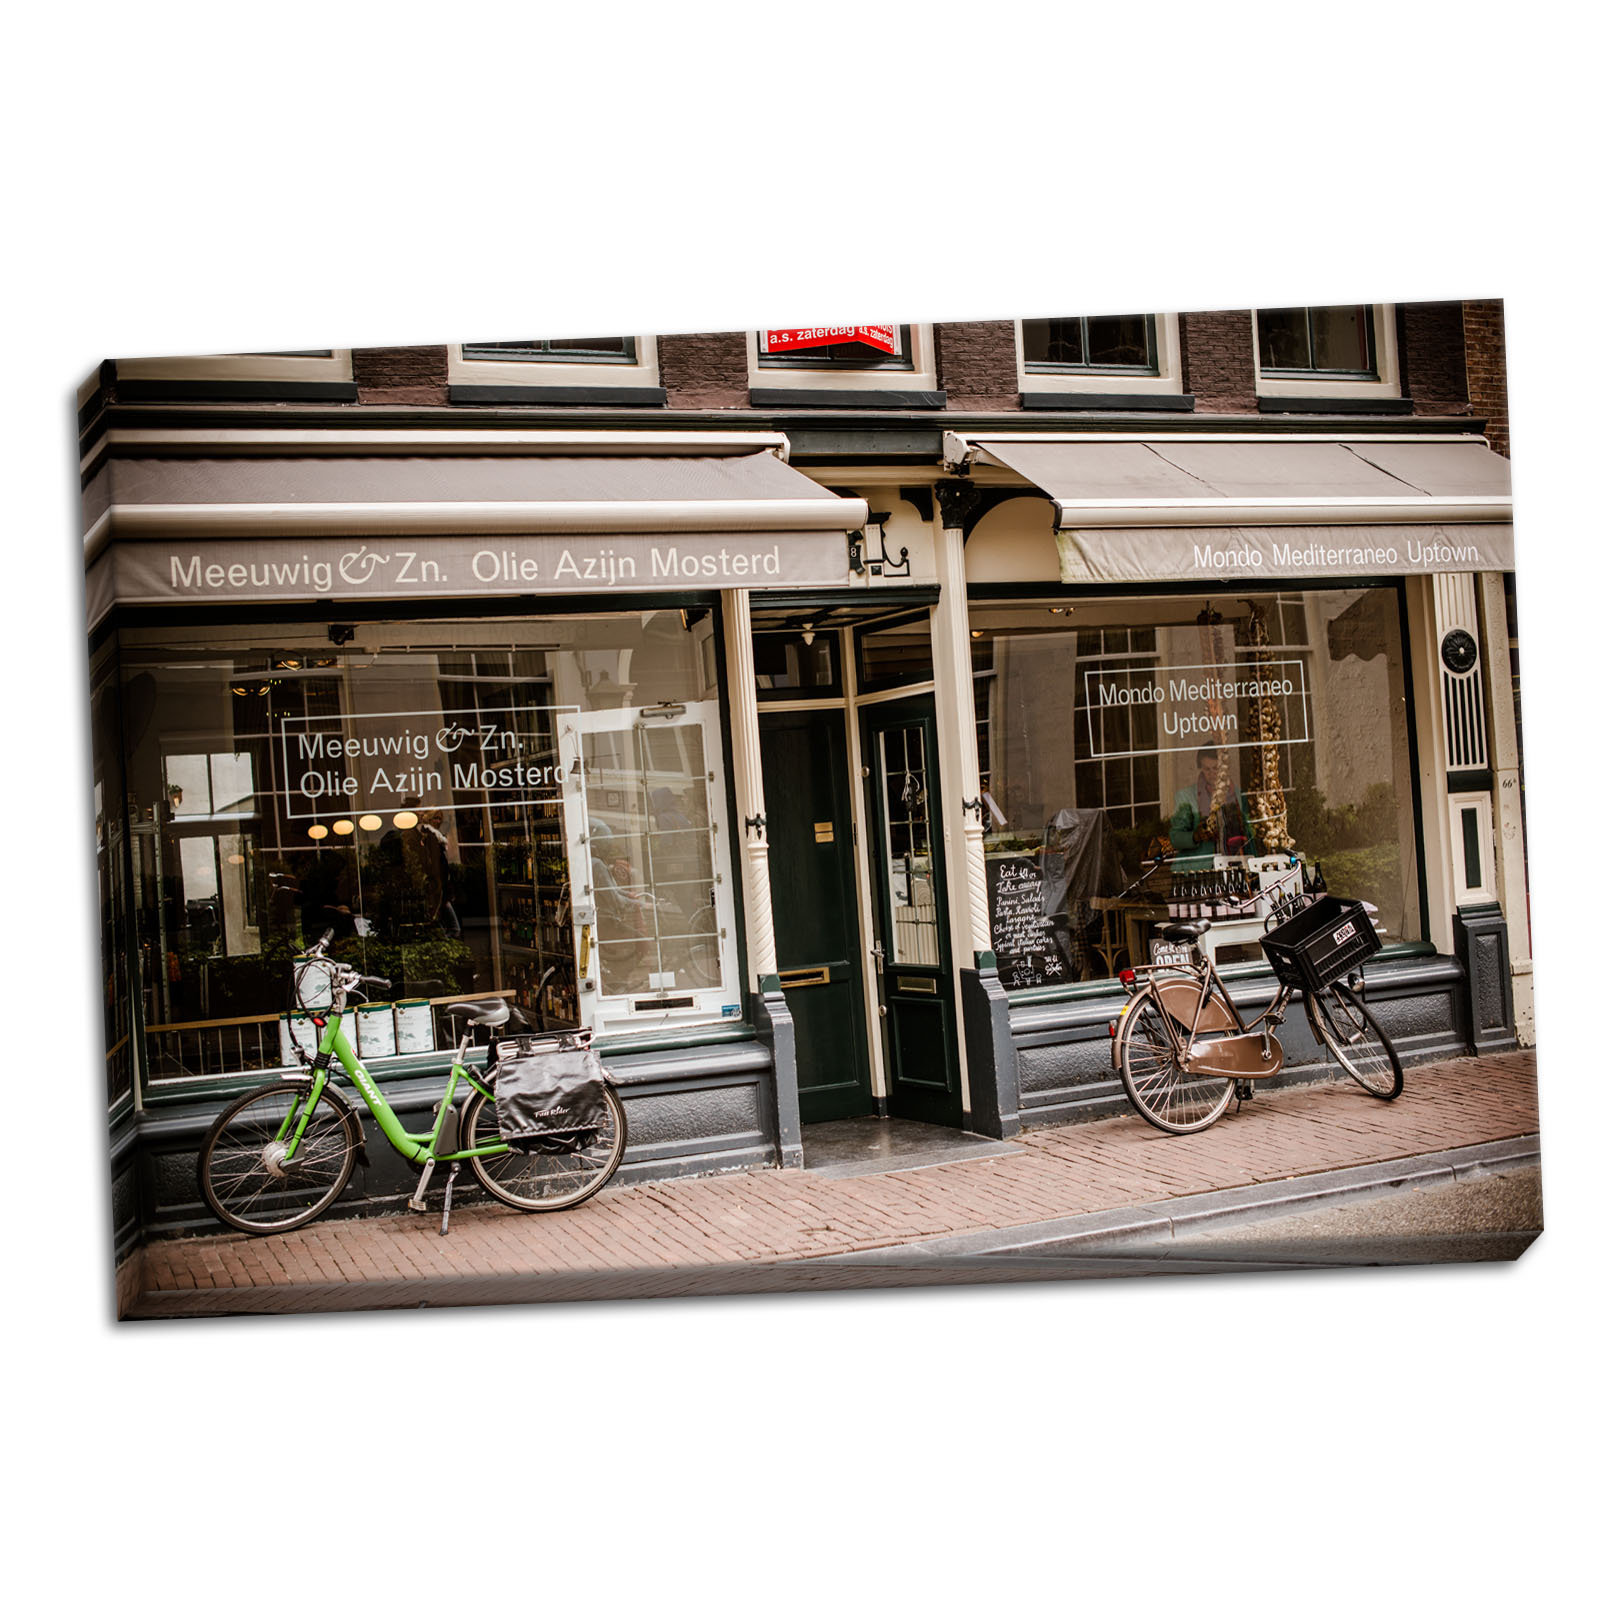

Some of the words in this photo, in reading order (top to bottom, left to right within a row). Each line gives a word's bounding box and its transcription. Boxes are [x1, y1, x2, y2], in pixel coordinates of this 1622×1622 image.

[770, 332, 793, 344] a.s.
[797, 326, 855, 341] zaterdag
[1194, 544, 1263, 568] Mondo
[1272, 543, 1398, 566] Mediterraneo
[1407, 540, 1479, 567] Uptown
[170, 555, 332, 592] Meeuwig
[339, 545, 390, 585] &
[395, 552, 448, 583] Zn.
[472, 550, 539, 582] Olie
[554, 550, 636, 585] Azijn
[651, 545, 780, 577] Mosterd
[1099, 681, 1165, 706] Mondo
[1169, 678, 1293, 701] Mediterraneo
[1163, 712, 1238, 738] Uptown
[299, 729, 429, 760] Meeuwig
[435, 722, 475, 753] &
[480, 724, 524, 751] Zn.
[300, 770, 359, 799] Olie
[370, 766, 443, 798] Azijn
[454, 761, 569, 789] Mosterd
[1000, 864, 1017, 878] Eat
[996, 880, 1017, 893] Take
[1018, 881, 1041, 893] away
[355, 1069, 382, 1106] GIANT
